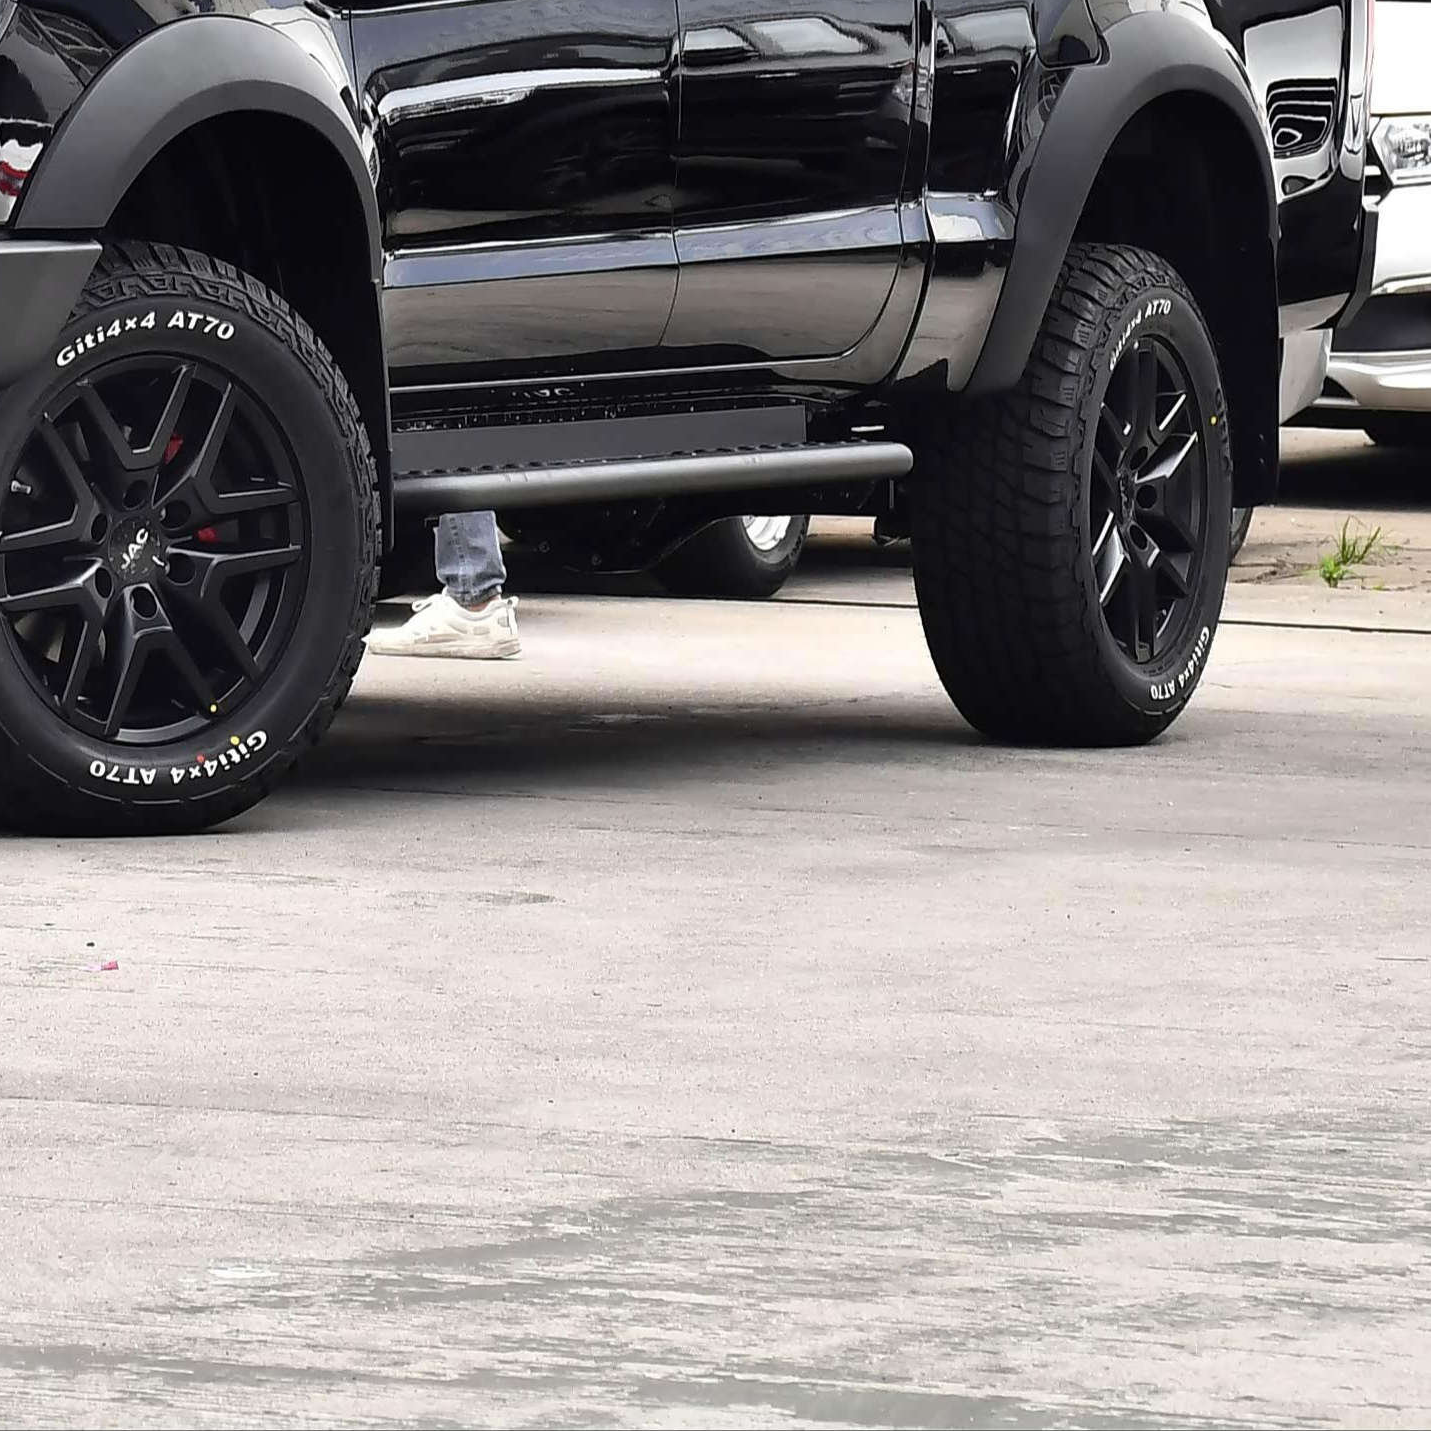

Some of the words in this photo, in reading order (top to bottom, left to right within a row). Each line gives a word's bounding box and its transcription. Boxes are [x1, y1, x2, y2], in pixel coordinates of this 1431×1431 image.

[1144, 299, 1172, 319] AT70
[56, 311, 156, 367] Giti4x4
[167, 311, 235, 340] AT70
[121, 528, 149, 570] JAC
[1150, 679, 1176, 700] AT70
[89, 760, 157, 785] AT70
[170, 730, 268, 785] Giti4x4
